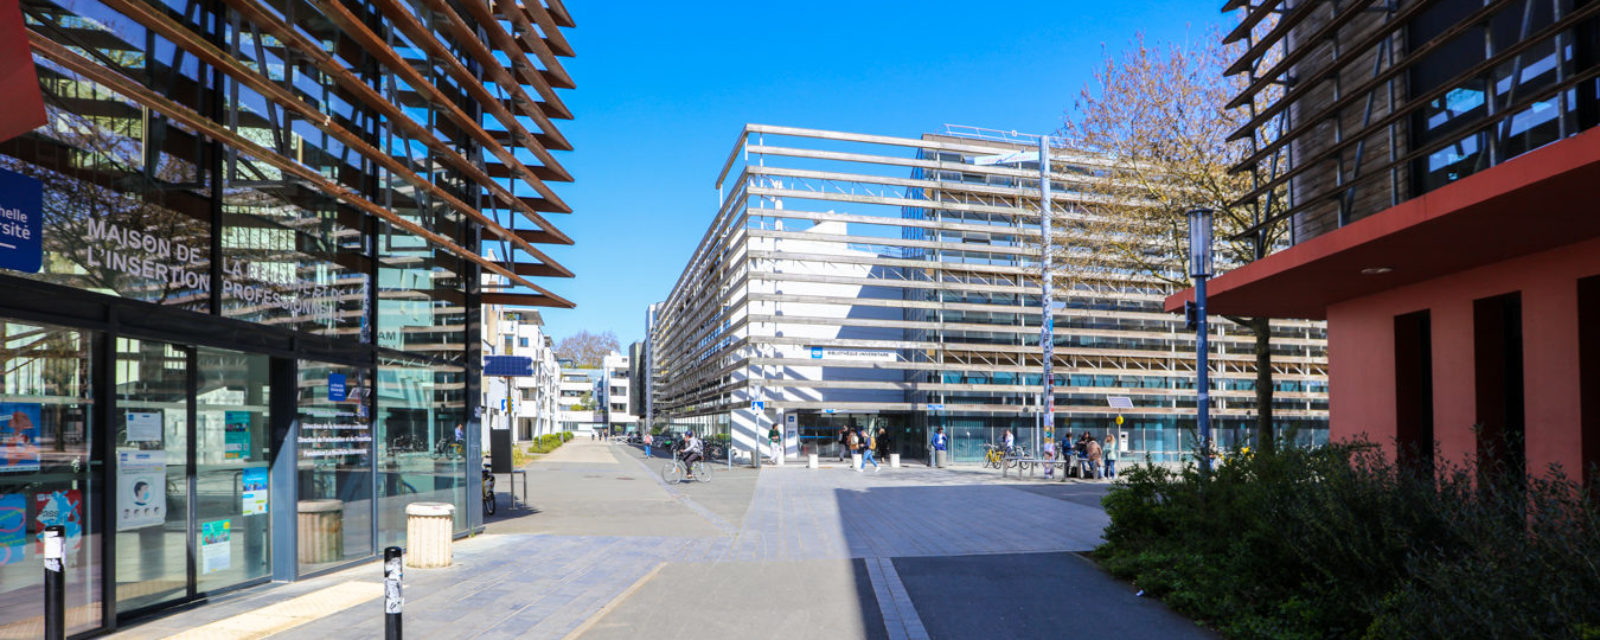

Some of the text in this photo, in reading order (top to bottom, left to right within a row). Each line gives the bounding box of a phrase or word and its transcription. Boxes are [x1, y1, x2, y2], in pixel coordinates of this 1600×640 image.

[0, 221, 31, 240] sité
[88, 217, 171, 257] MAISON
[177, 243, 200, 265] DE
[222, 256, 243, 279] LA
[87, 245, 211, 292] L'INSERTION
